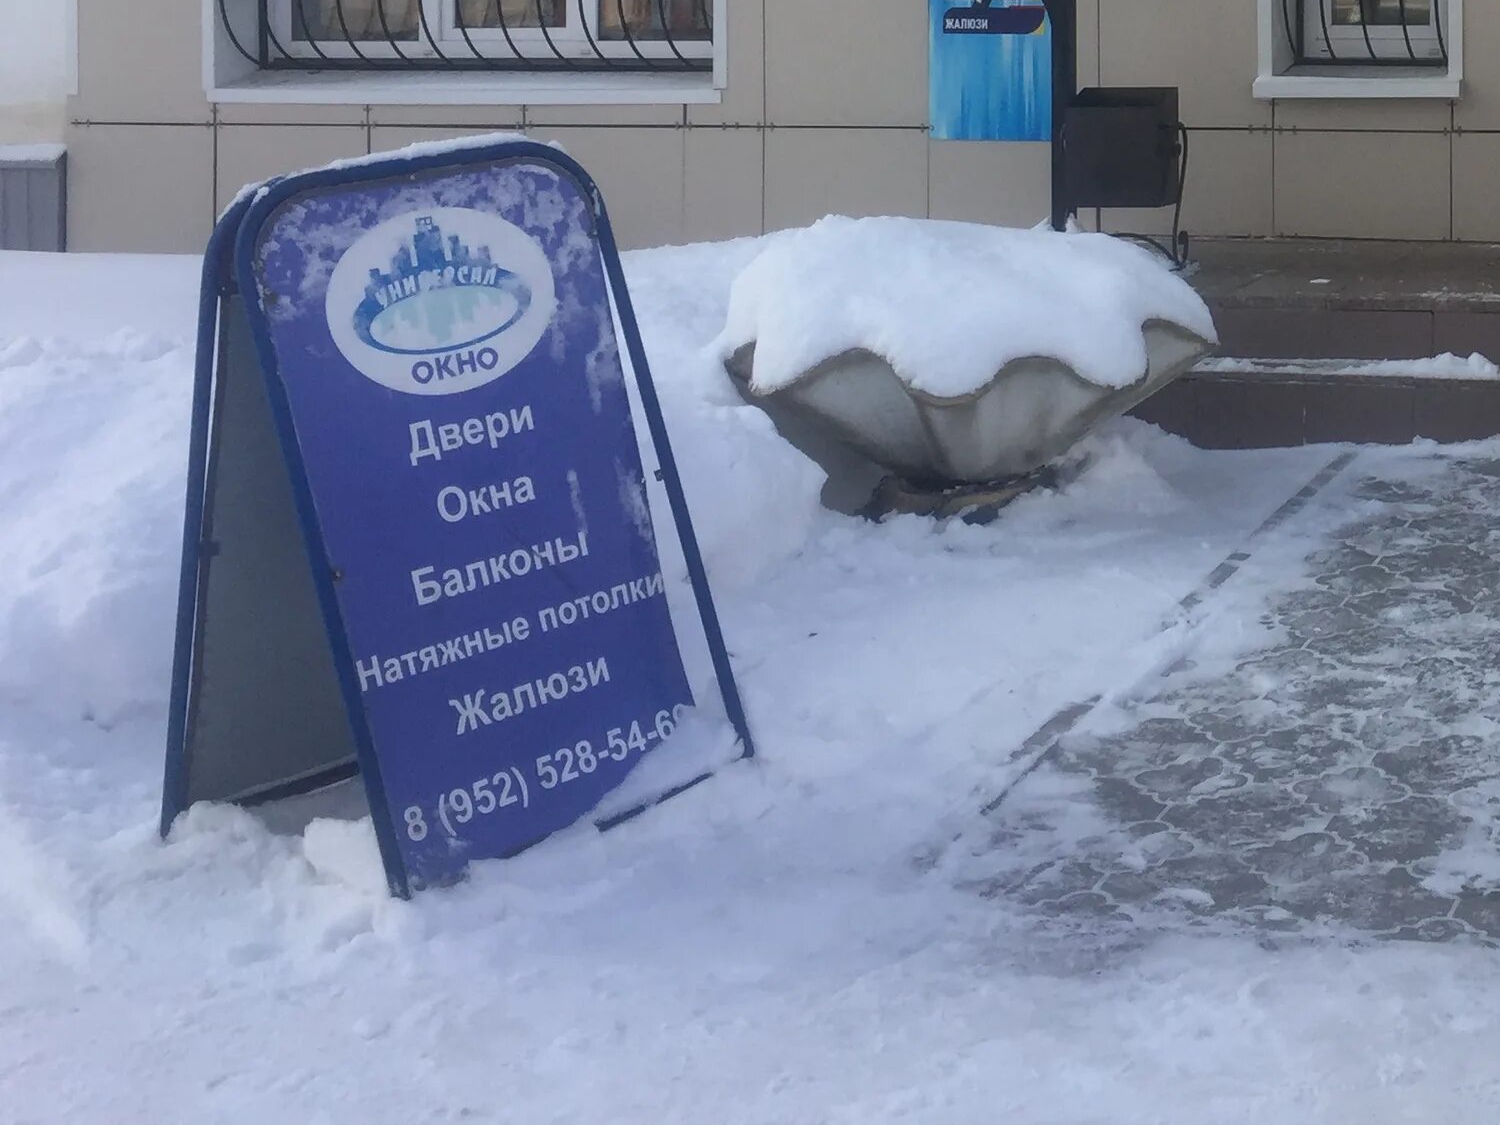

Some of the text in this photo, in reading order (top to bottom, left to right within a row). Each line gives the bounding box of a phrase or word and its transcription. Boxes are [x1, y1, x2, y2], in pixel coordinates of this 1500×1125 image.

[945, 18, 989, 30] ЖАЛЮЗИ
[411, 347, 499, 384] ОКНО
[409, 405, 535, 466] Двери
[437, 476, 536, 522] Окна
[411, 531, 589, 606] Балконы
[355, 571, 664, 692] Натяжные потолки
[449, 657, 611, 735] Жалюзи
[404, 806, 428, 842] 8
[438, 767, 529, 837] (952)
